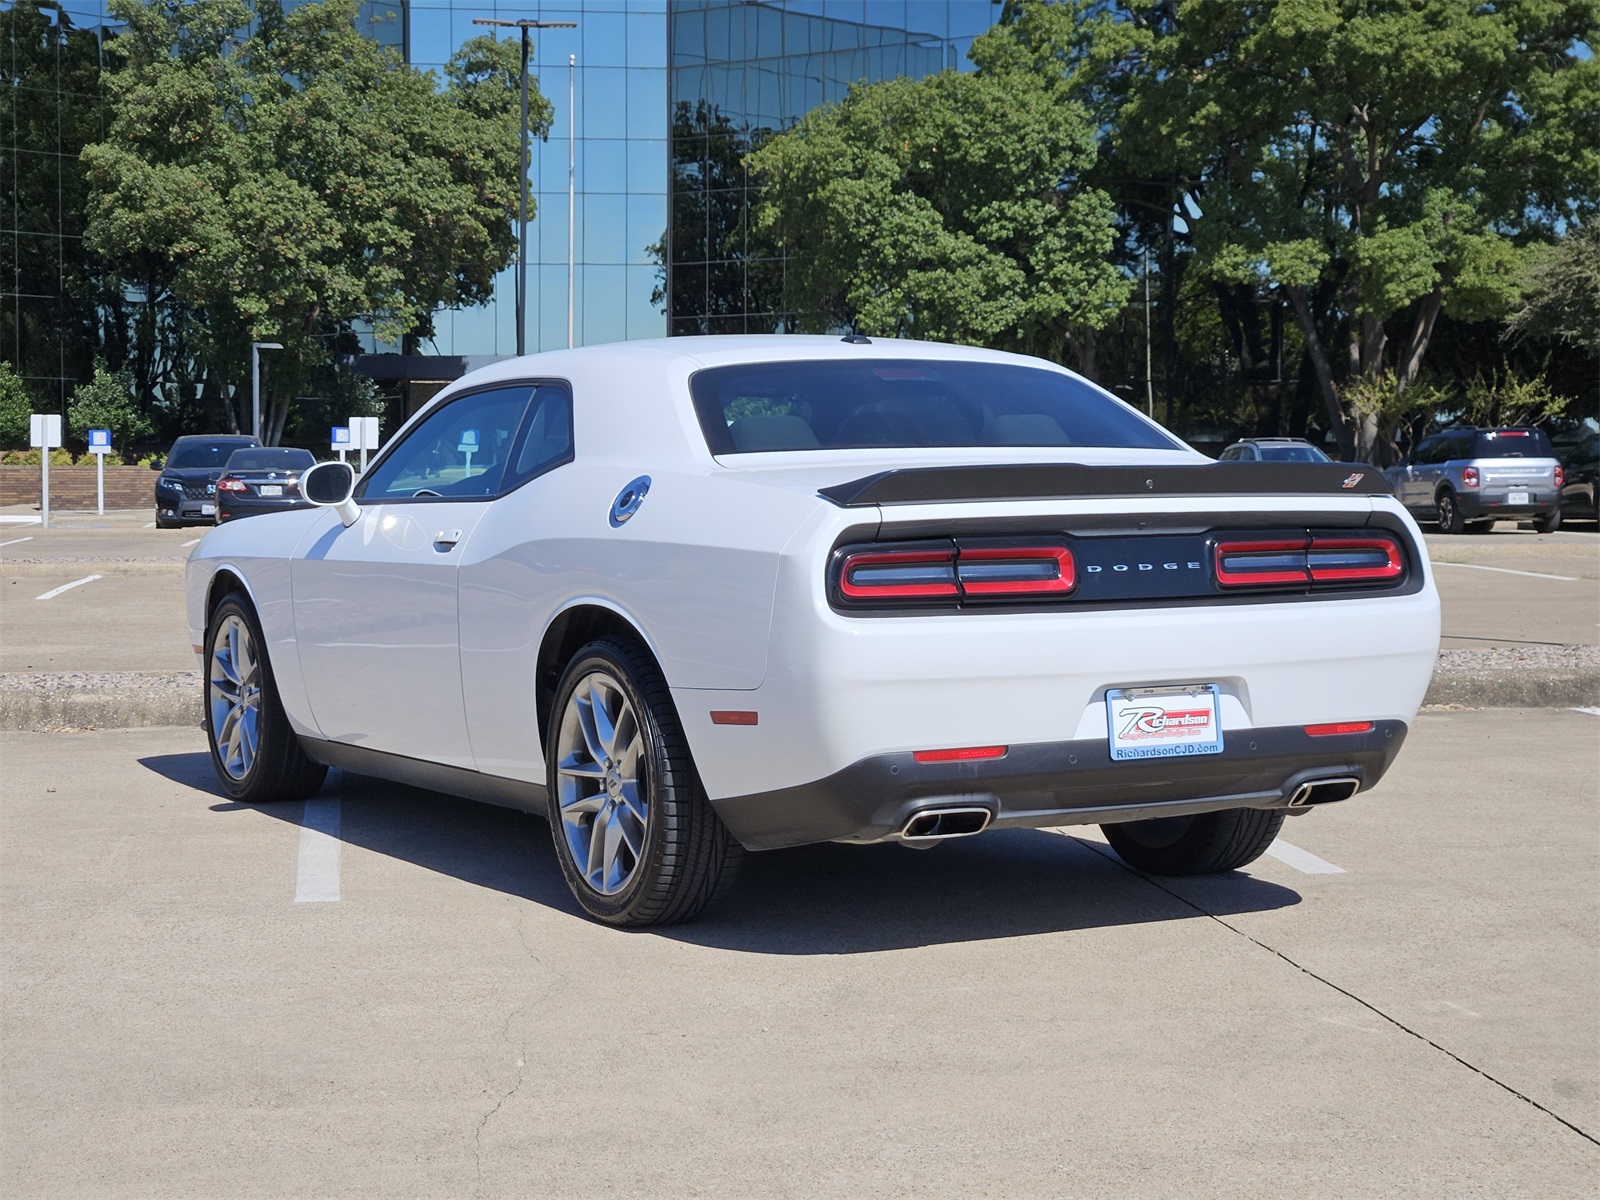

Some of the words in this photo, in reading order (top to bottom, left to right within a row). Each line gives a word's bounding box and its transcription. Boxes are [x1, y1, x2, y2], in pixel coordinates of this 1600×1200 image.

[1086, 561, 1201, 573] DODGE
[1118, 706, 1208, 739] Richardson
[1116, 744, 1218, 759] RichardsonCJD.com
